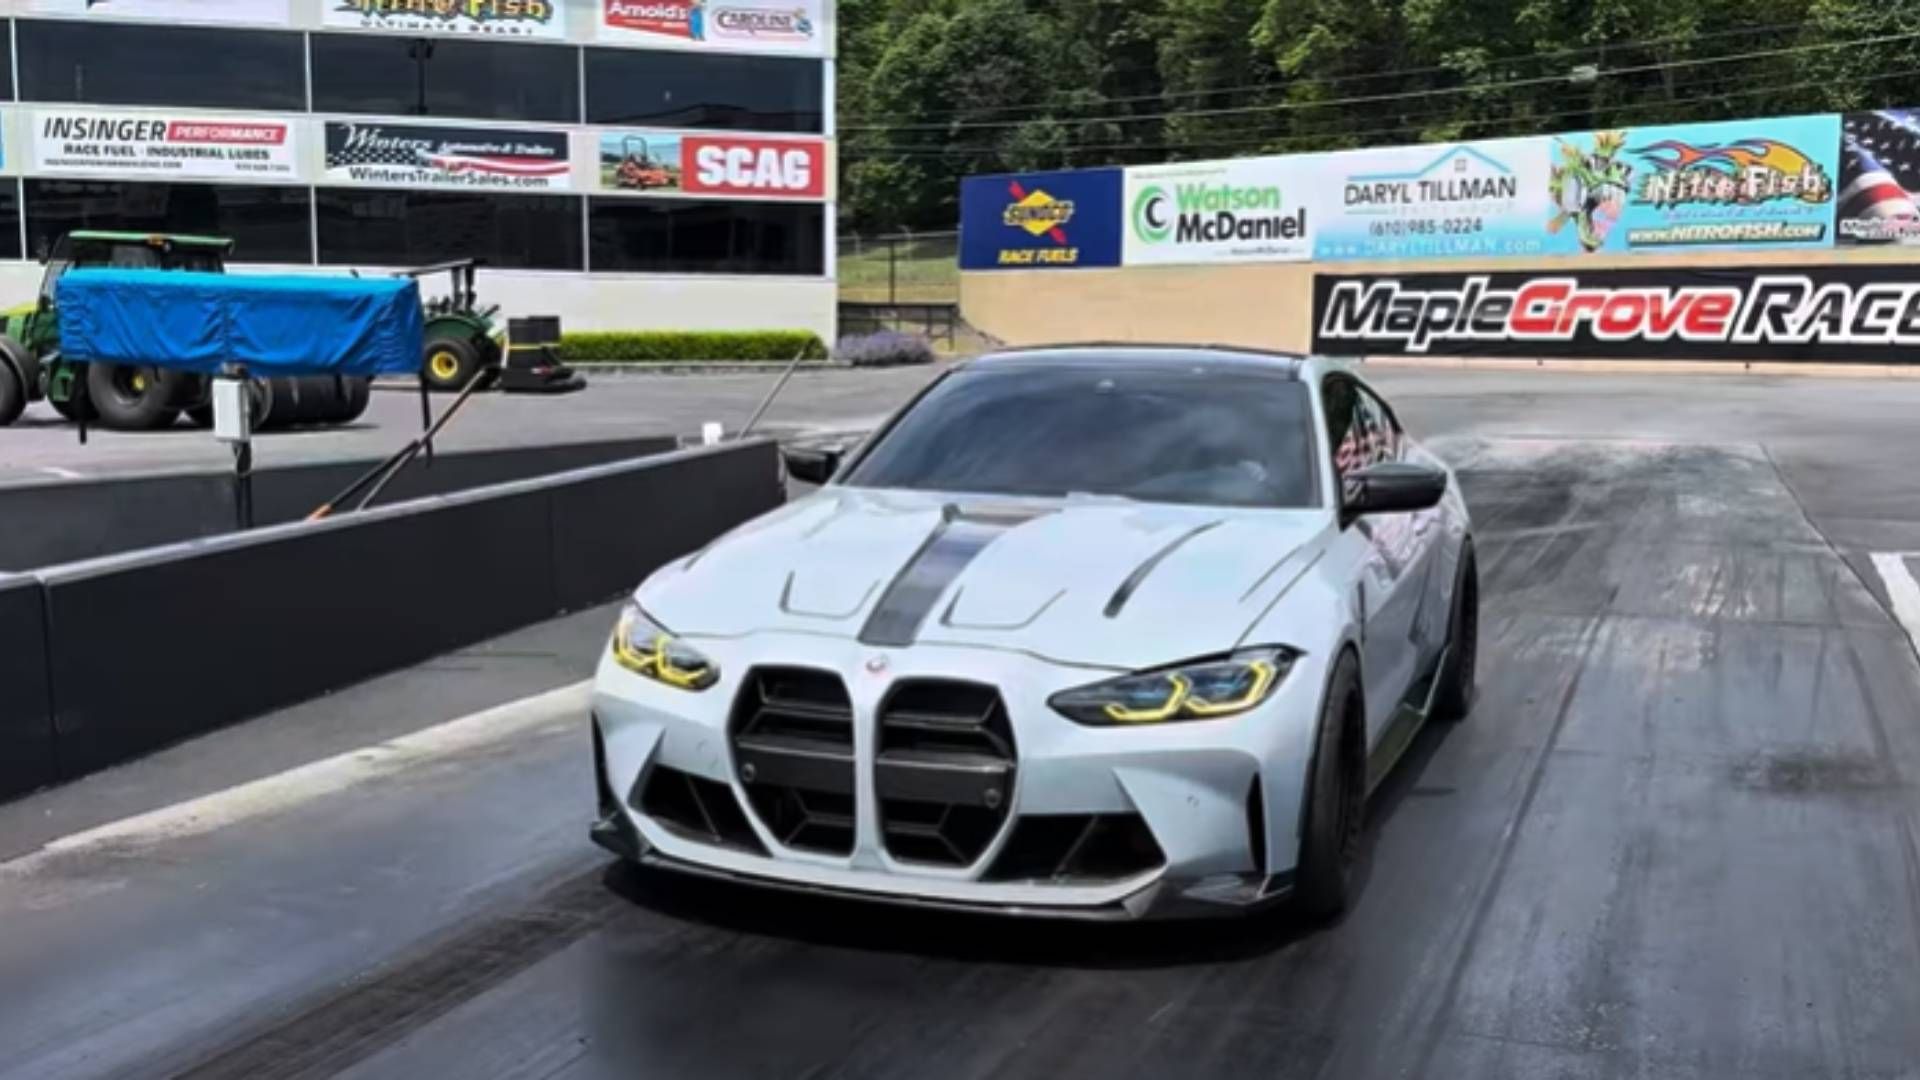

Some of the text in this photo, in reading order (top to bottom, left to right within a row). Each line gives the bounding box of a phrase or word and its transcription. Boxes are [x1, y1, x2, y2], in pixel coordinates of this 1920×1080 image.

[44, 117, 278, 142] INSINGER PERFORMANCE
[340, 124, 433, 151] Winters
[63, 144, 100, 157] RACE
[103, 145, 137, 157] FUEL
[146, 147, 224, 160] INDUSTRIAL
[350, 167, 549, 187] WintersTrailerSales.com
[696, 145, 811, 190] SCAG
[1175, 183, 1281, 212] Watson
[1344, 176, 1517, 206] DARYL TILLMAN
[1176, 207, 1307, 244] McDaniel
